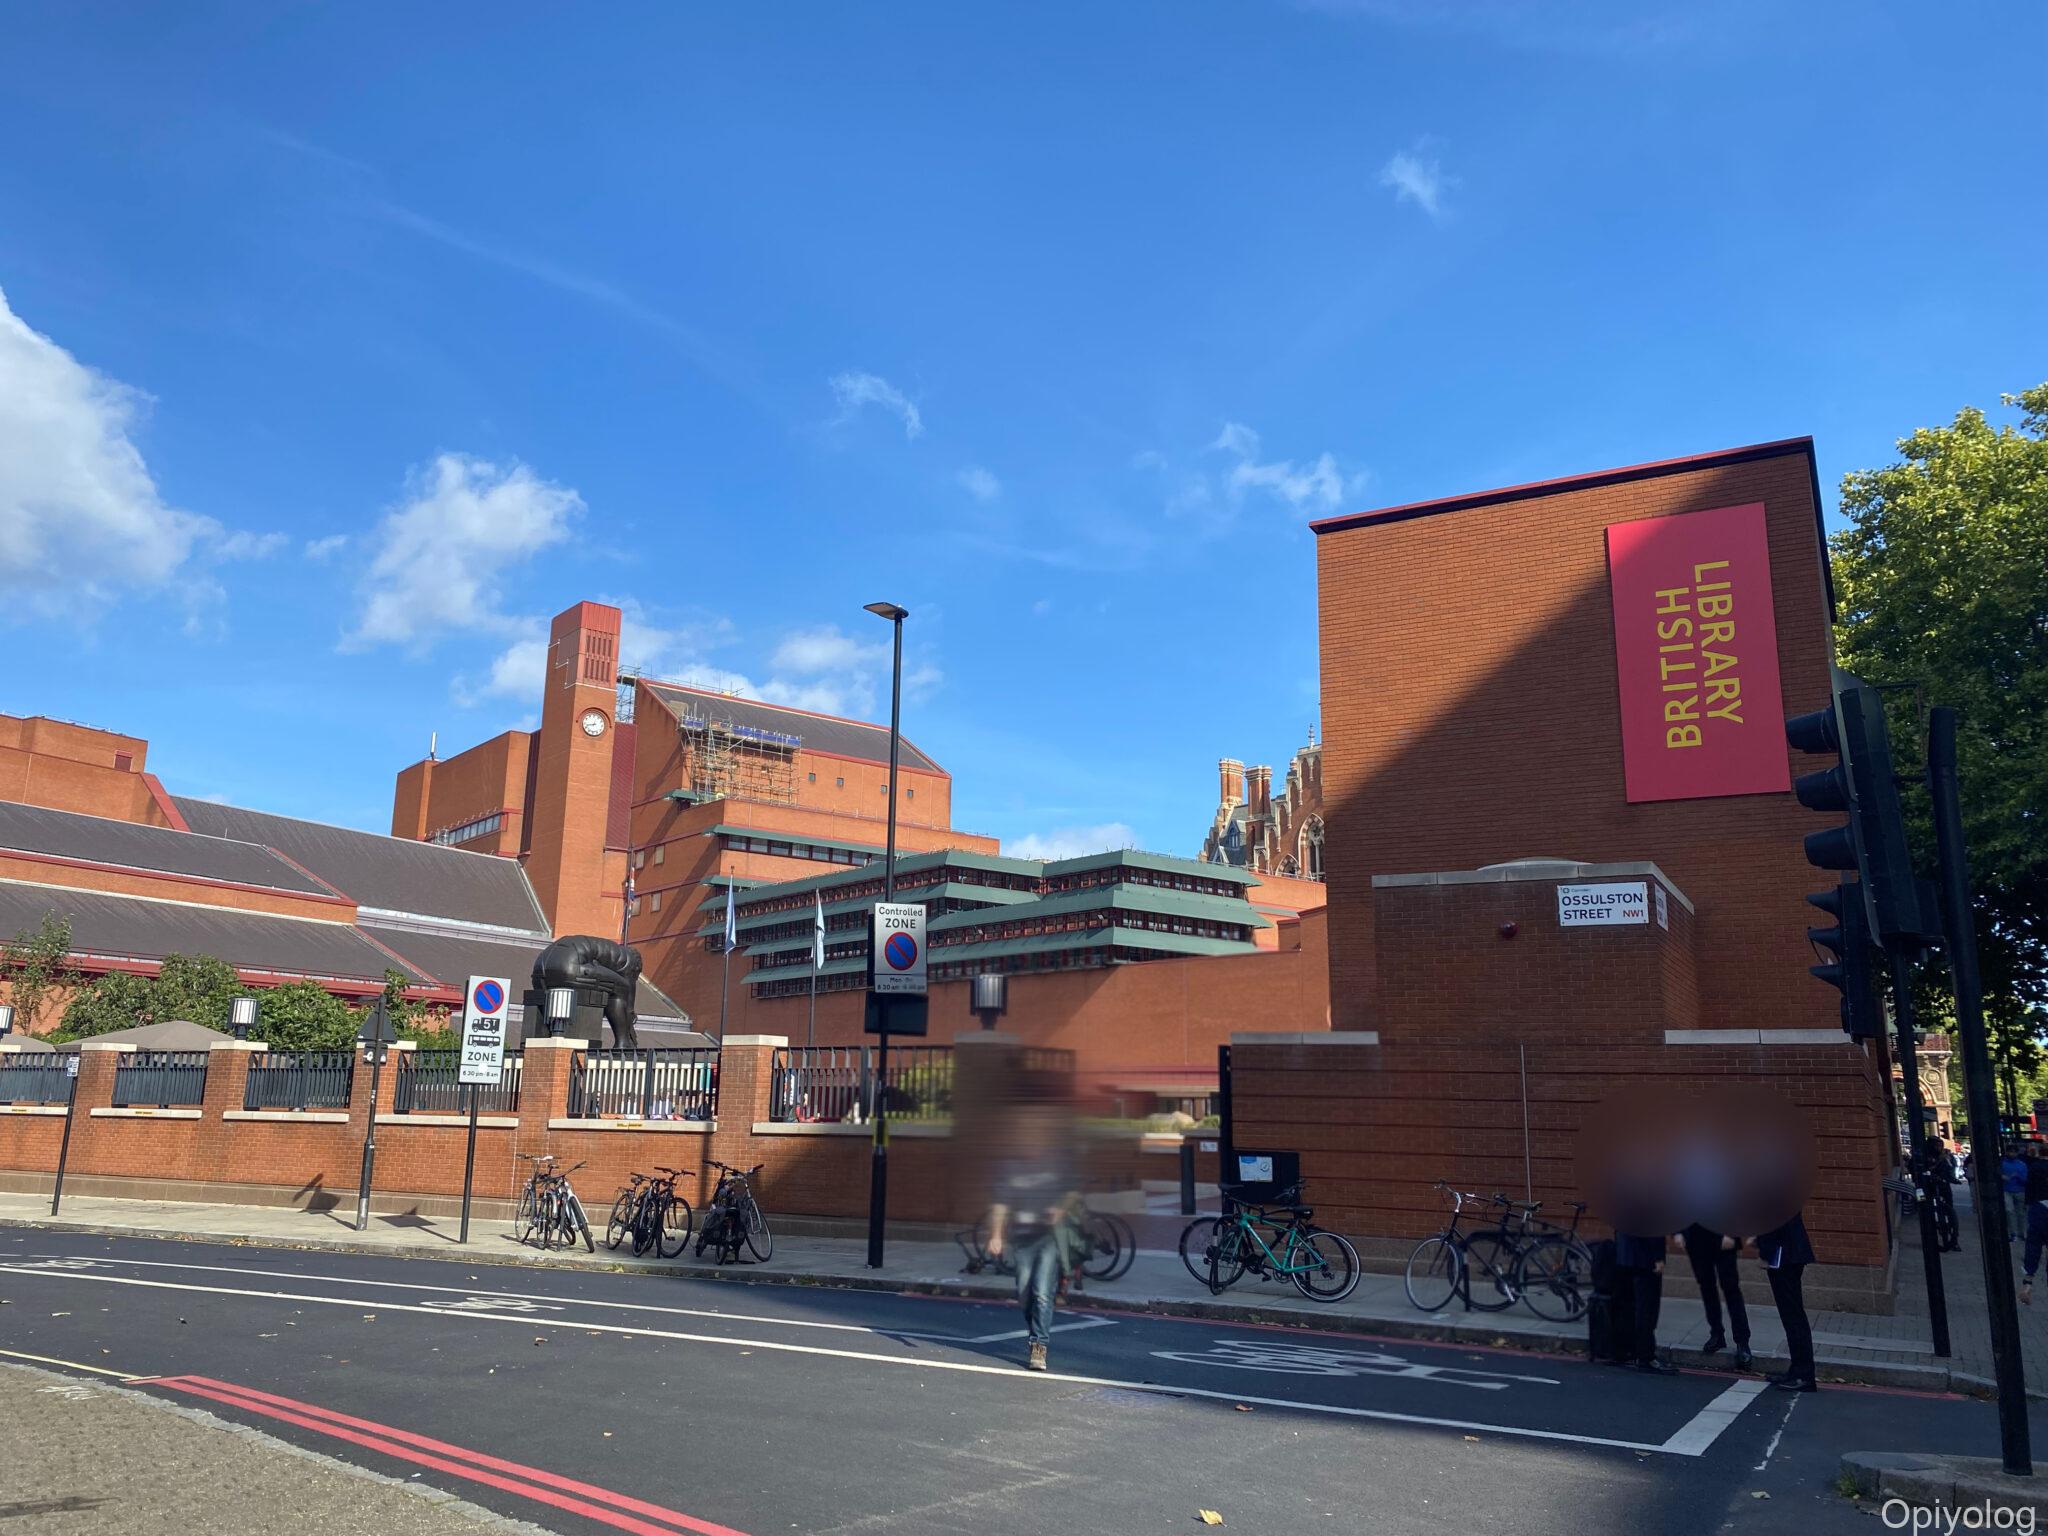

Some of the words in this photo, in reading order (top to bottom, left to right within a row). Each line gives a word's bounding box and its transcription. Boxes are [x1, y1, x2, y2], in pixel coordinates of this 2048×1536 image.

[1694, 560, 1744, 724] LIBRARY
[1656, 587, 1702, 748] BRITISH
[1562, 893, 1643, 906] OSSULSTON
[879, 907, 923, 917] Controlled
[1563, 908, 1612, 920] STREET
[1622, 909, 1644, 918] NW1
[885, 918, 916, 929] ZONE
[467, 1051, 497, 1062] ZONE
